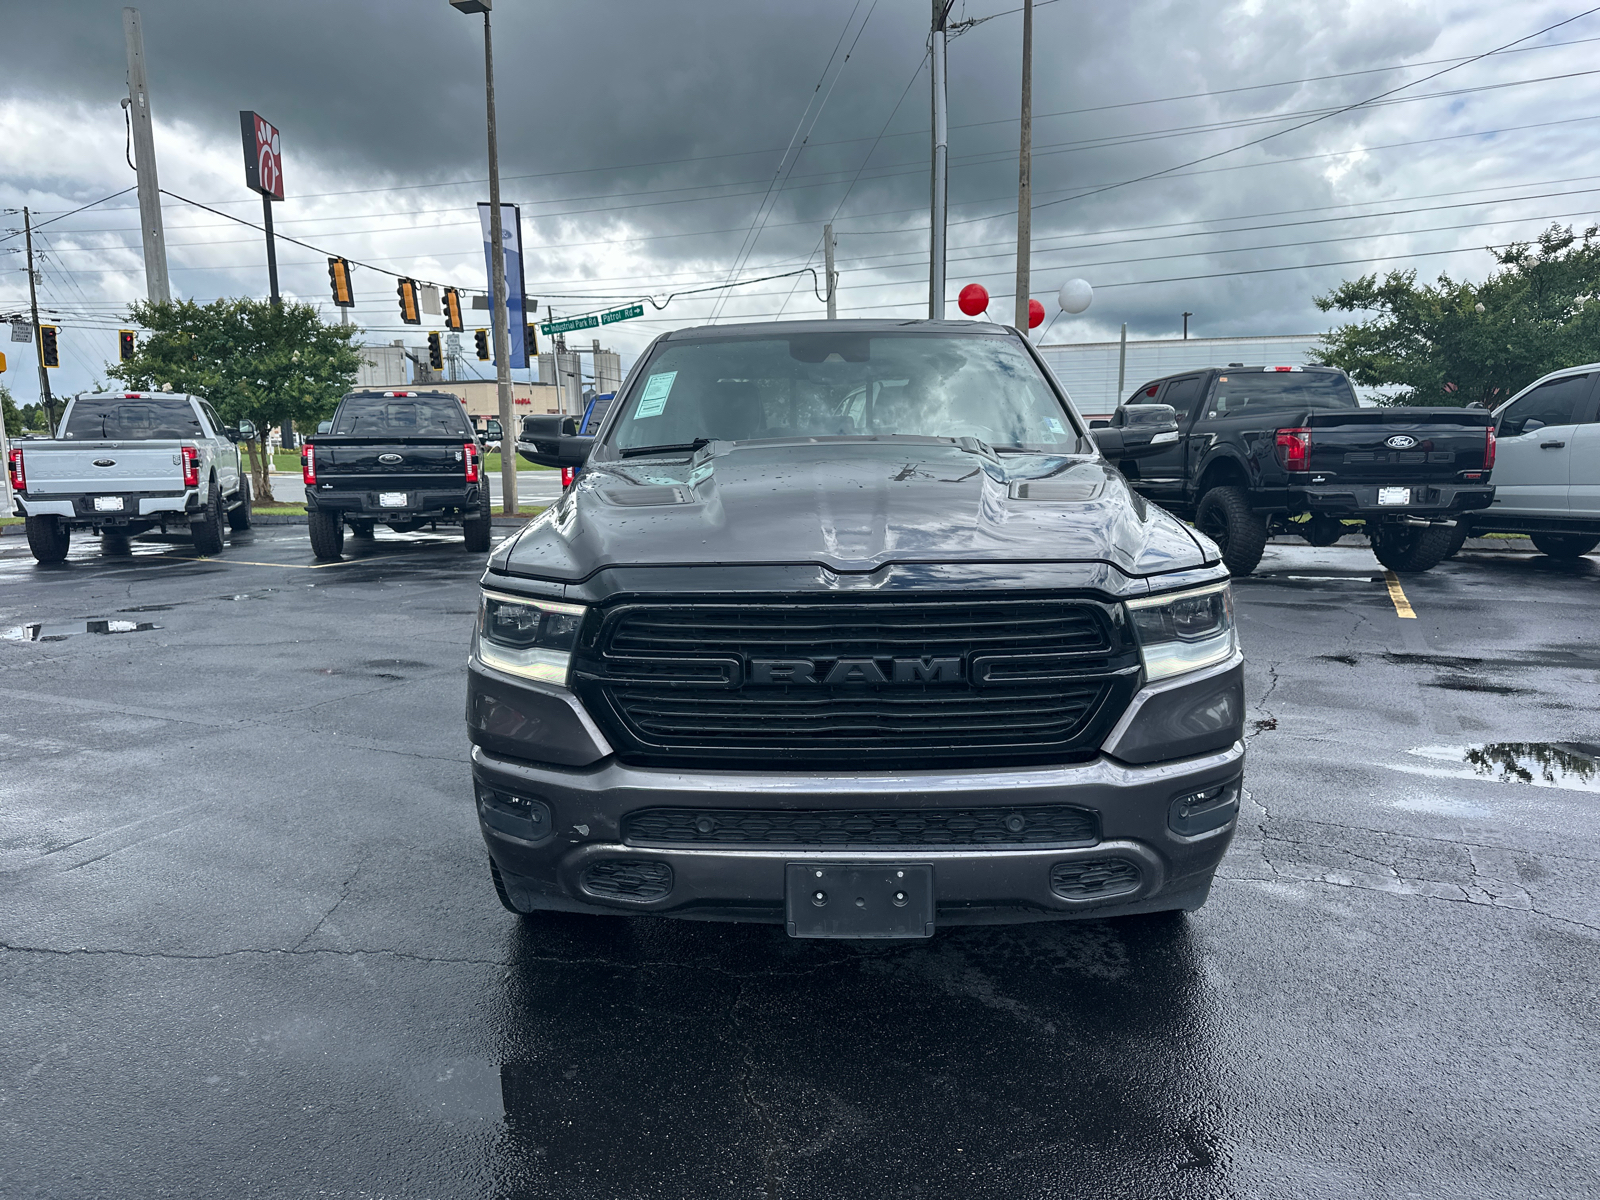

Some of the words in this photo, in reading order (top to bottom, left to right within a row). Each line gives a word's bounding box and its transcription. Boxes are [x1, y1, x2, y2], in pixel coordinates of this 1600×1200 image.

[603, 312, 621, 323] Patrol
[624, 308, 633, 317] Rd
[550, 321, 575, 333] Industrial
[575, 319, 588, 328] Park
[588, 317, 597, 326] Rd
[1343, 451, 1456, 464] F-150
[751, 657, 961, 684] RAM
